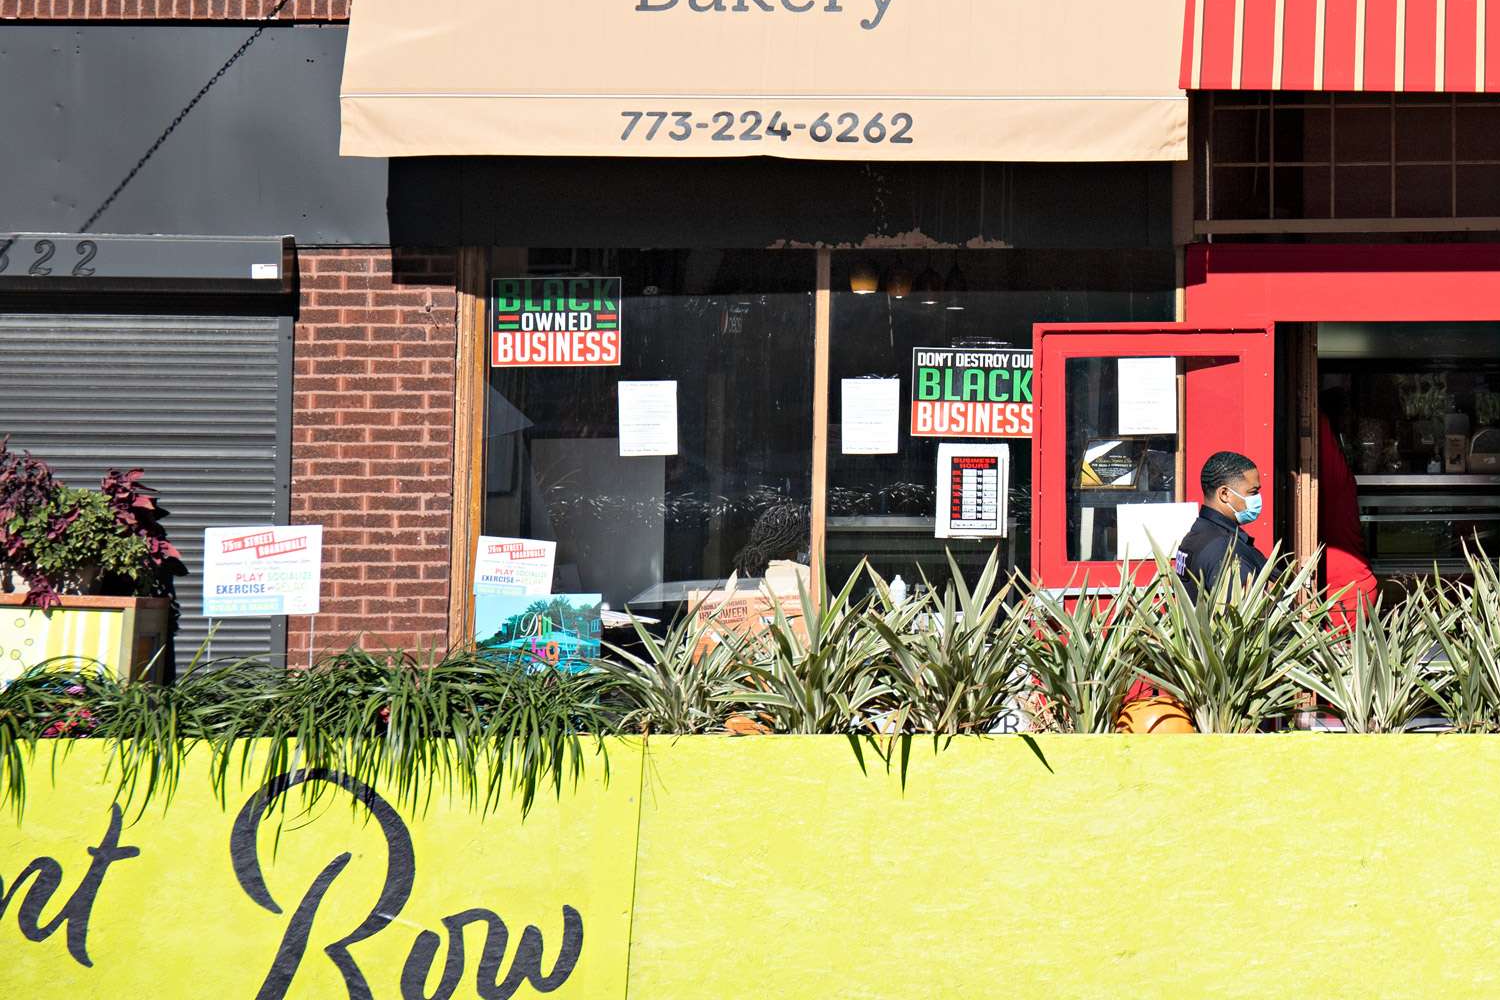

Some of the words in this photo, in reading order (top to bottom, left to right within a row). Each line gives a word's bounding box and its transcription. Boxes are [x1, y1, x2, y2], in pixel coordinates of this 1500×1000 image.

[620, 110, 914, 145] 773-224-6262
[498, 279, 616, 312] BLACK
[521, 312, 592, 331] OWNED
[497, 331, 617, 363] BUSINESS
[917, 352, 953, 367] DON'T
[955, 354, 1009, 368] DESTROY
[1012, 355, 1034, 369] OU
[918, 368, 1034, 403] BLACK
[917, 401, 1034, 434] BUSINESS
[216, 583, 265, 594] EXERCISE
[235, 572, 264, 582] PLAY
